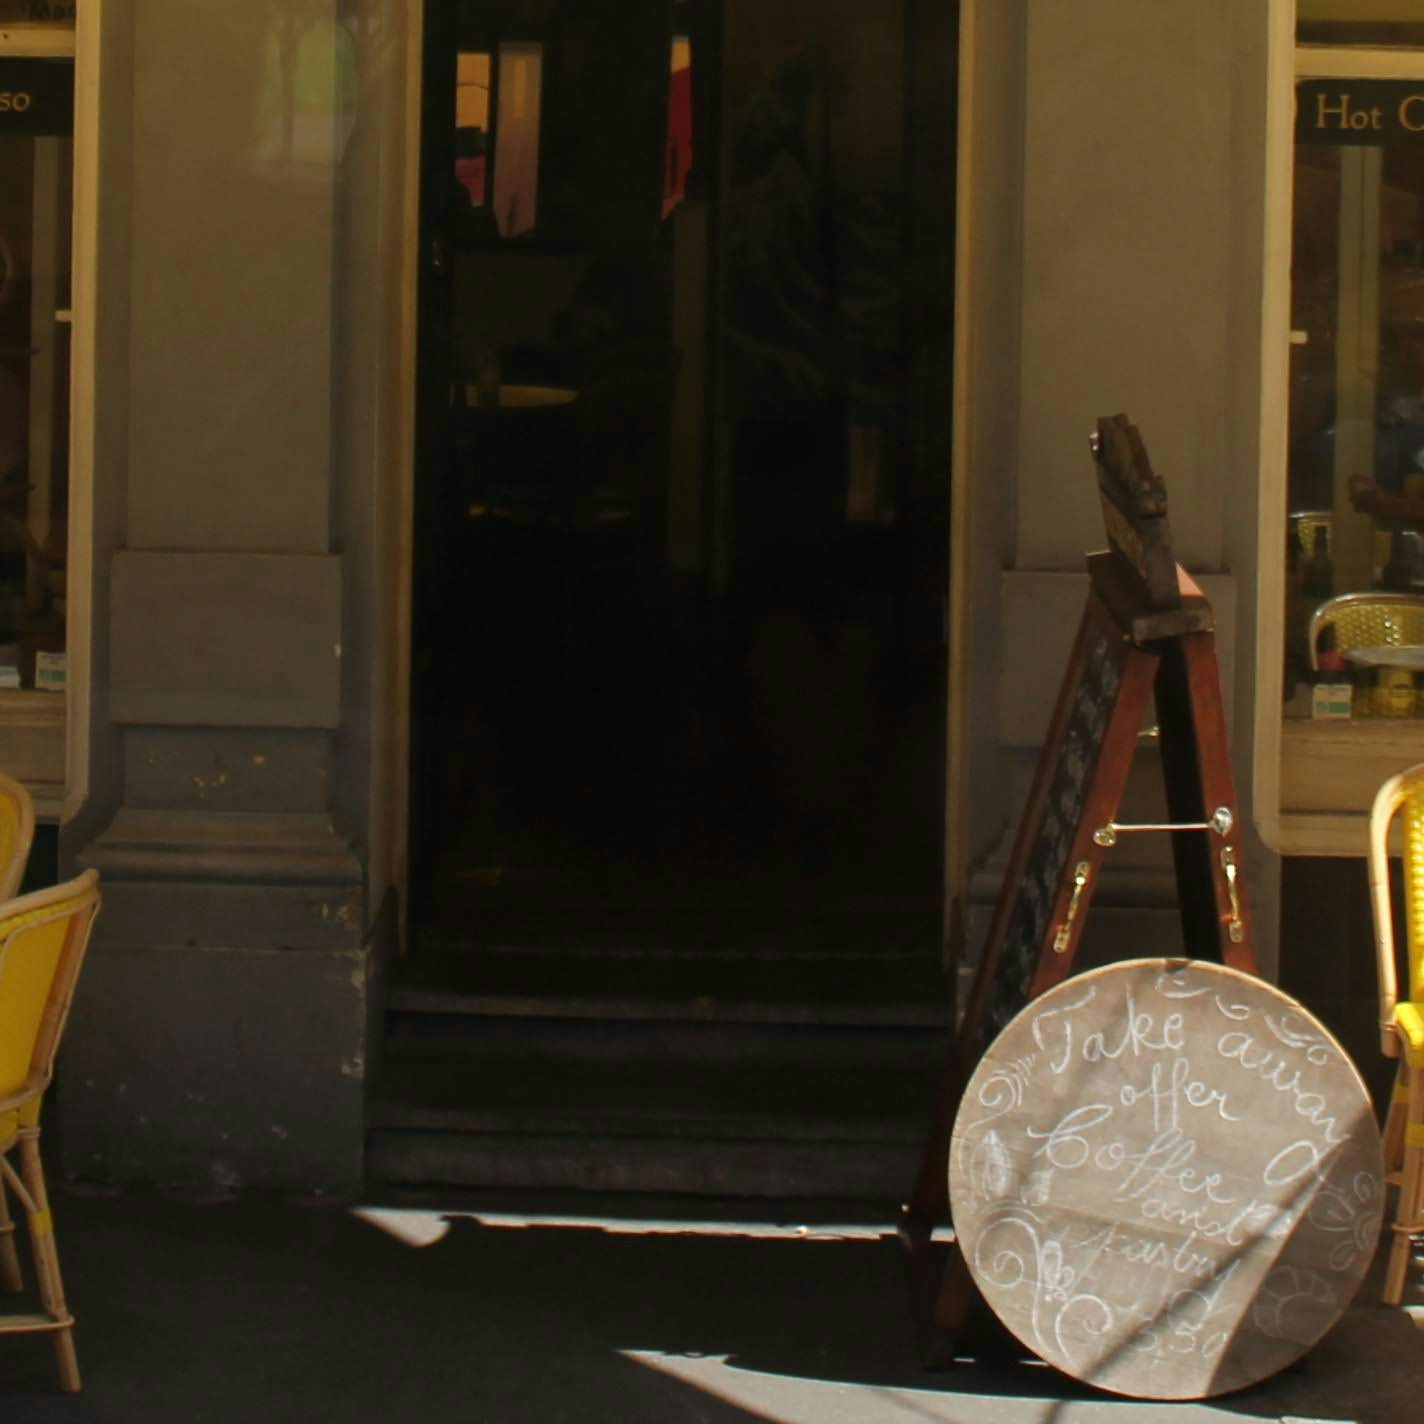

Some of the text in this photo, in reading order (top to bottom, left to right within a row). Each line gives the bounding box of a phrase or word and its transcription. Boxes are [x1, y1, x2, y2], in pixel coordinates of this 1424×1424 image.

[1314, 94, 1383, 134] Hot
[1031, 982, 1186, 1075] Take
[1119, 1057, 1241, 1133] offer
[1026, 1103, 1238, 1205] Coffee
[1140, 1196, 1260, 1248] and
